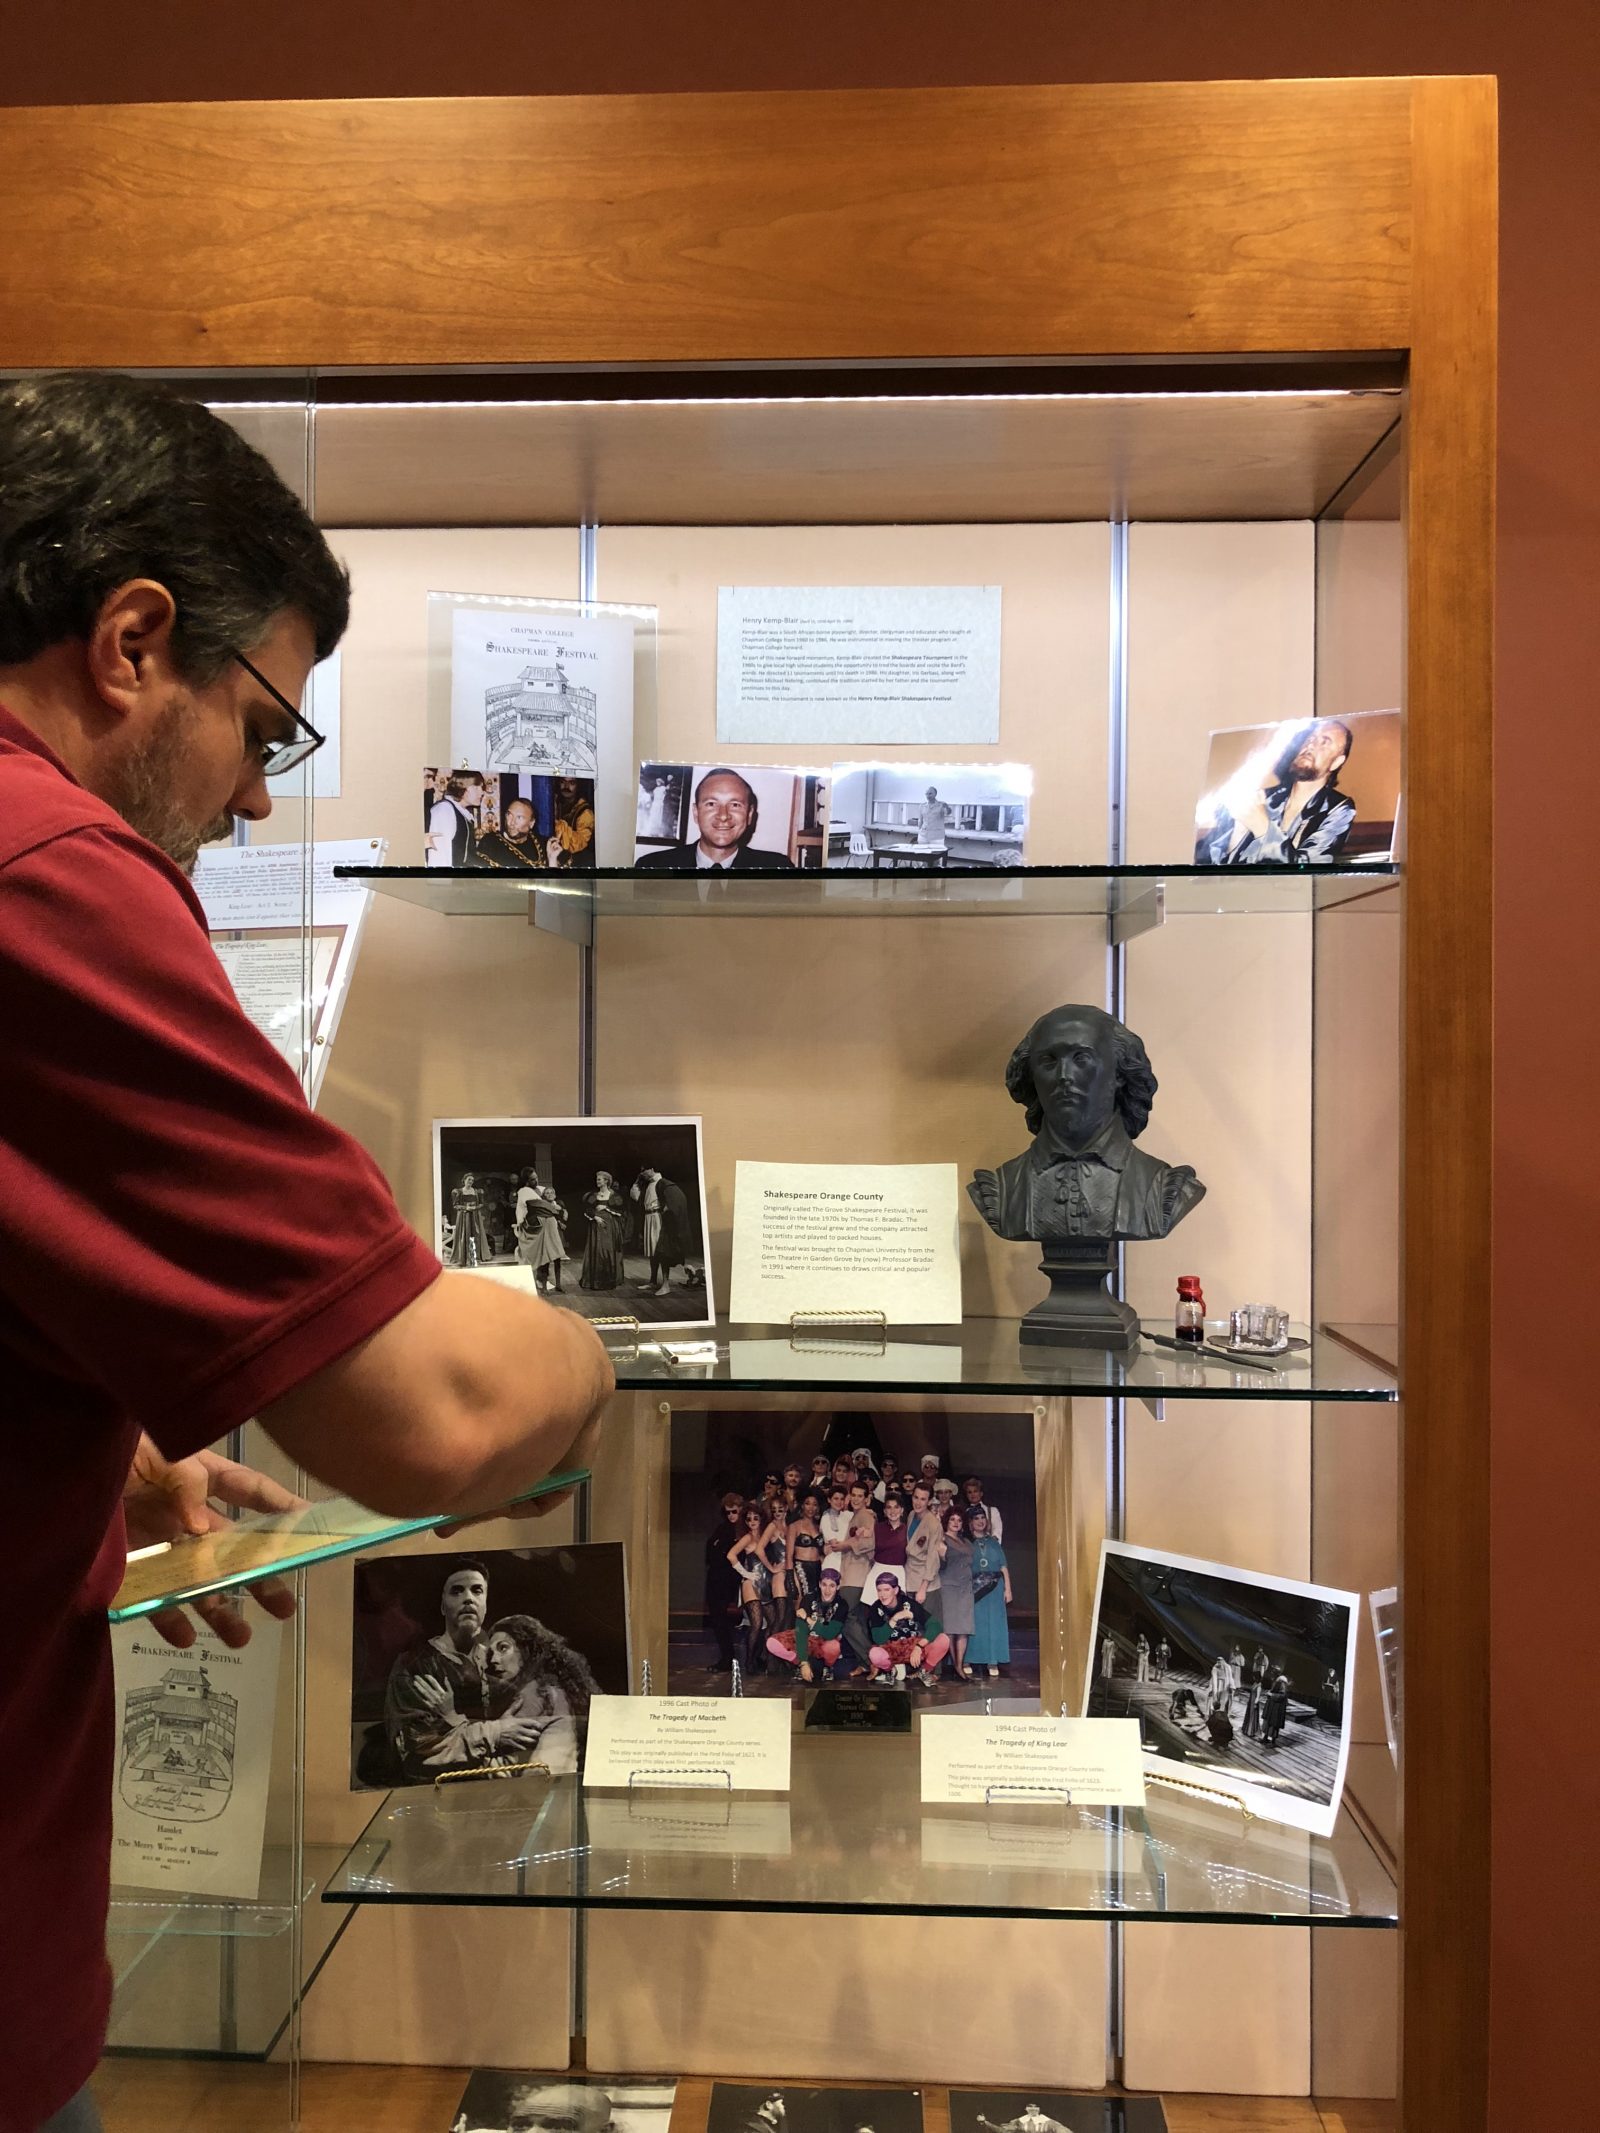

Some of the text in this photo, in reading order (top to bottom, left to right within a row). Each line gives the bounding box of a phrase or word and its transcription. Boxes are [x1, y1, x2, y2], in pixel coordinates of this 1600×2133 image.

[742, 617, 762, 625] Henry
[763, 617, 798, 625] Kemp-Blair
[510, 627, 542, 635] CHAPMAN
[486, 642, 598, 660] SHAKESPEARE FESTIVAL
[240, 850, 254, 858] The
[256, 849, 298, 858] Shakespeare
[764, 1190, 883, 1202] Shakespeare Orange County
[764, 1205, 792, 1213] Originally
[844, 1206, 882, 1214] Shakespeare
[840, 1215, 848, 1223] by
[762, 1232, 773, 1240] top
[807, 1233, 827, 1242] played
[836, 1234, 858, 1242] packed
[811, 1245, 836, 1254] brought
[845, 1246, 874, 1254] Chapman
[875, 1246, 906, 1255] University
[853, 1255, 861, 1263] by
[862, 1256, 881, 1264] (now)
[906, 1266, 930, 1274] popular
[132, 1642, 242, 1664] SHAKESPEARE FESTIVAL
[662, 1714, 688, 1722] Tragedy
[999, 1739, 1026, 1748] Tragedy
[1036, 1740, 1051, 1748] King
[157, 1824, 182, 1834] Hamlet
[117, 1838, 219, 1856] The Merry Wives of Windsor
